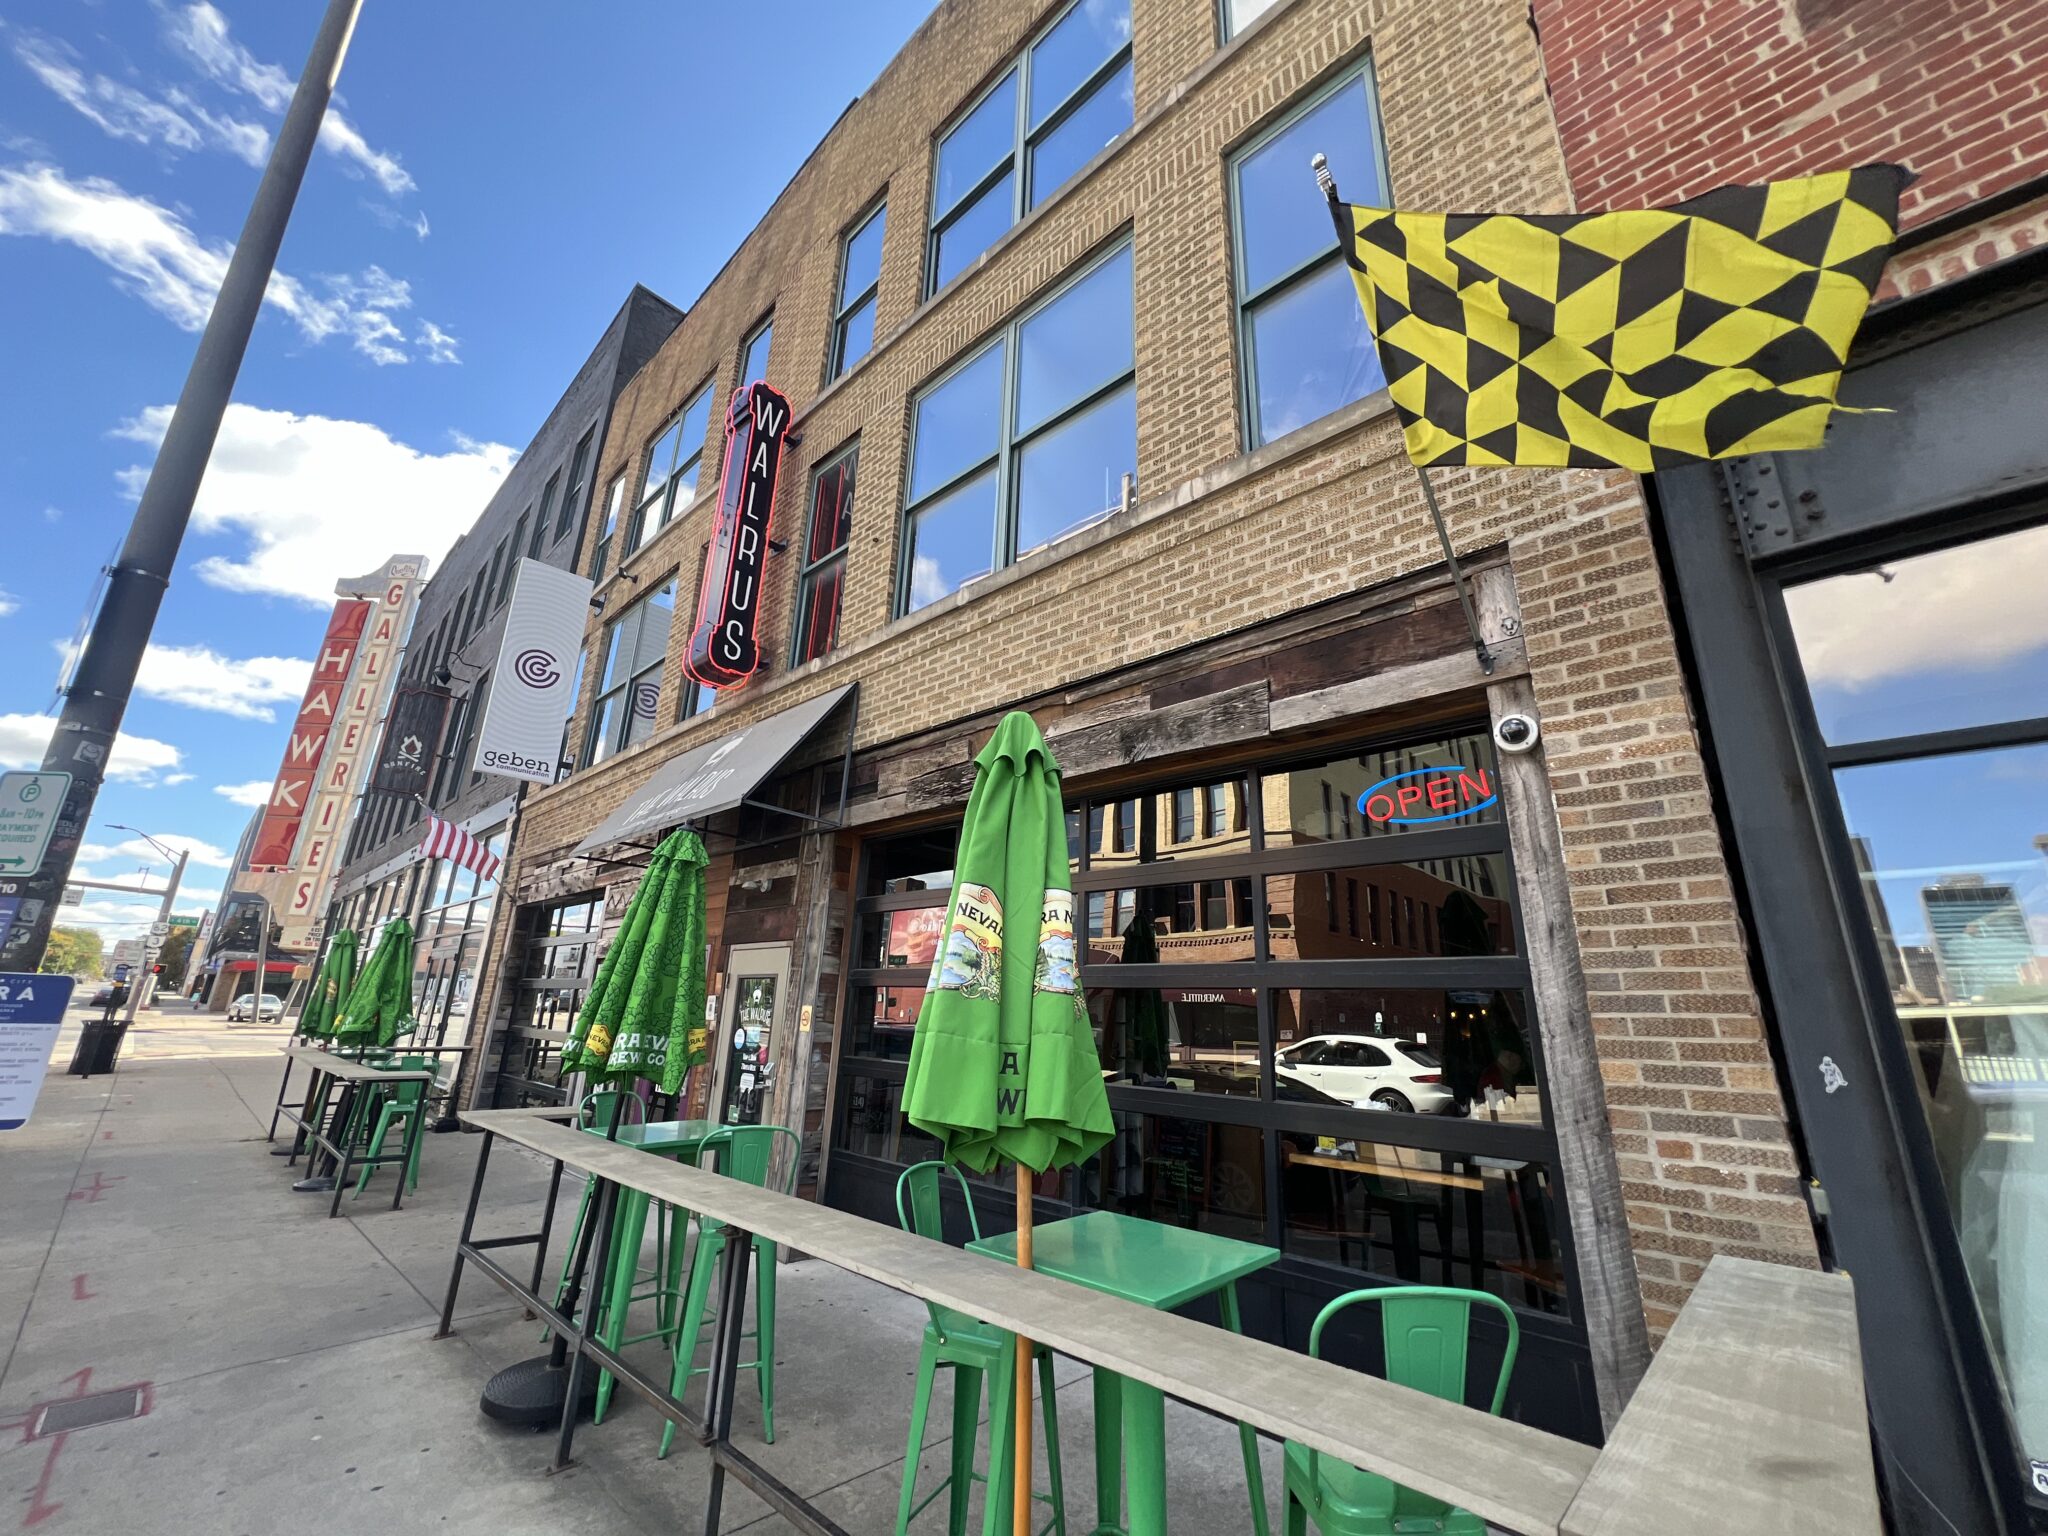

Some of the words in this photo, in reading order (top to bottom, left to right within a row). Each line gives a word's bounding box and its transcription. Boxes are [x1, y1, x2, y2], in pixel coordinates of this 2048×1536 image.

[723, 394, 784, 660] WALRUS
[273, 648, 350, 808] HAWK
[294, 584, 402, 909] GALLERIES
[384, 761, 426, 776] BONFIRE
[483, 751, 550, 772] geben
[496, 763, 549, 778] communication
[656, 769, 736, 809] WALRUS
[1366, 768, 1491, 822] OPEN
